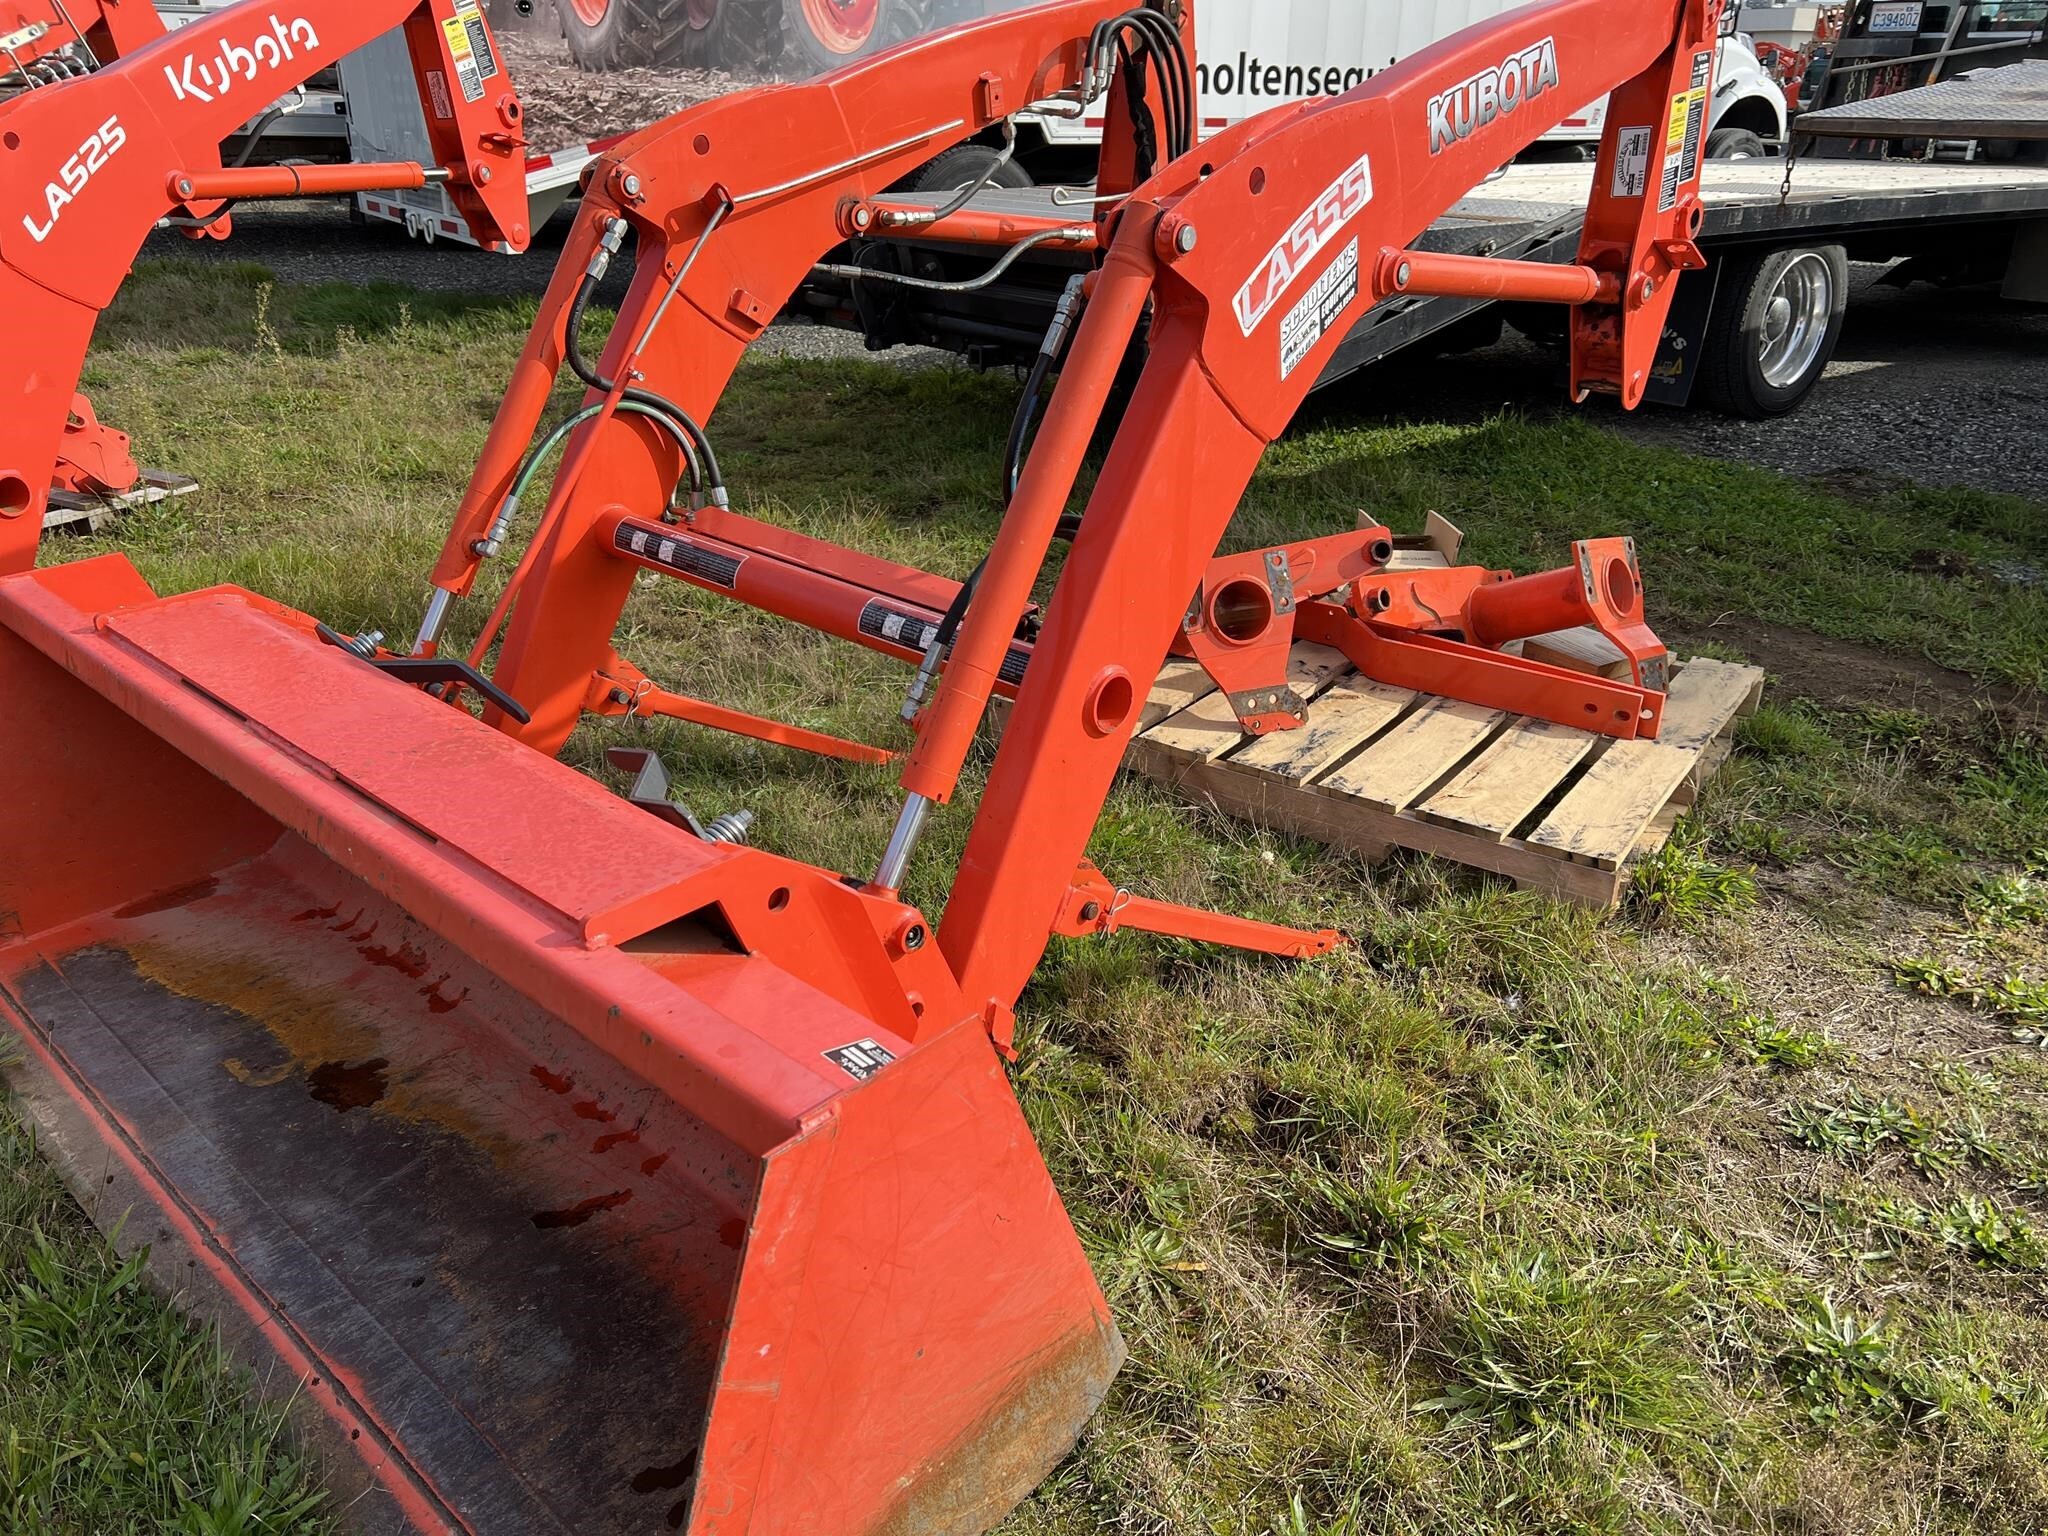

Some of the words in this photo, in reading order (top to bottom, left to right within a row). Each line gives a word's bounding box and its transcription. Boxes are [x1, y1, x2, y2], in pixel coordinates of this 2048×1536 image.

[163, 14, 320, 103] Kubota
[1196, 51, 1395, 97] oltense
[1428, 38, 1558, 154] KUBOTA
[22, 114, 127, 243] LA525
[1241, 162, 1367, 329] LA555
[1282, 242, 1358, 342] SCHOLTEN'S
[1321, 267, 1358, 319] EQUIPMENT
